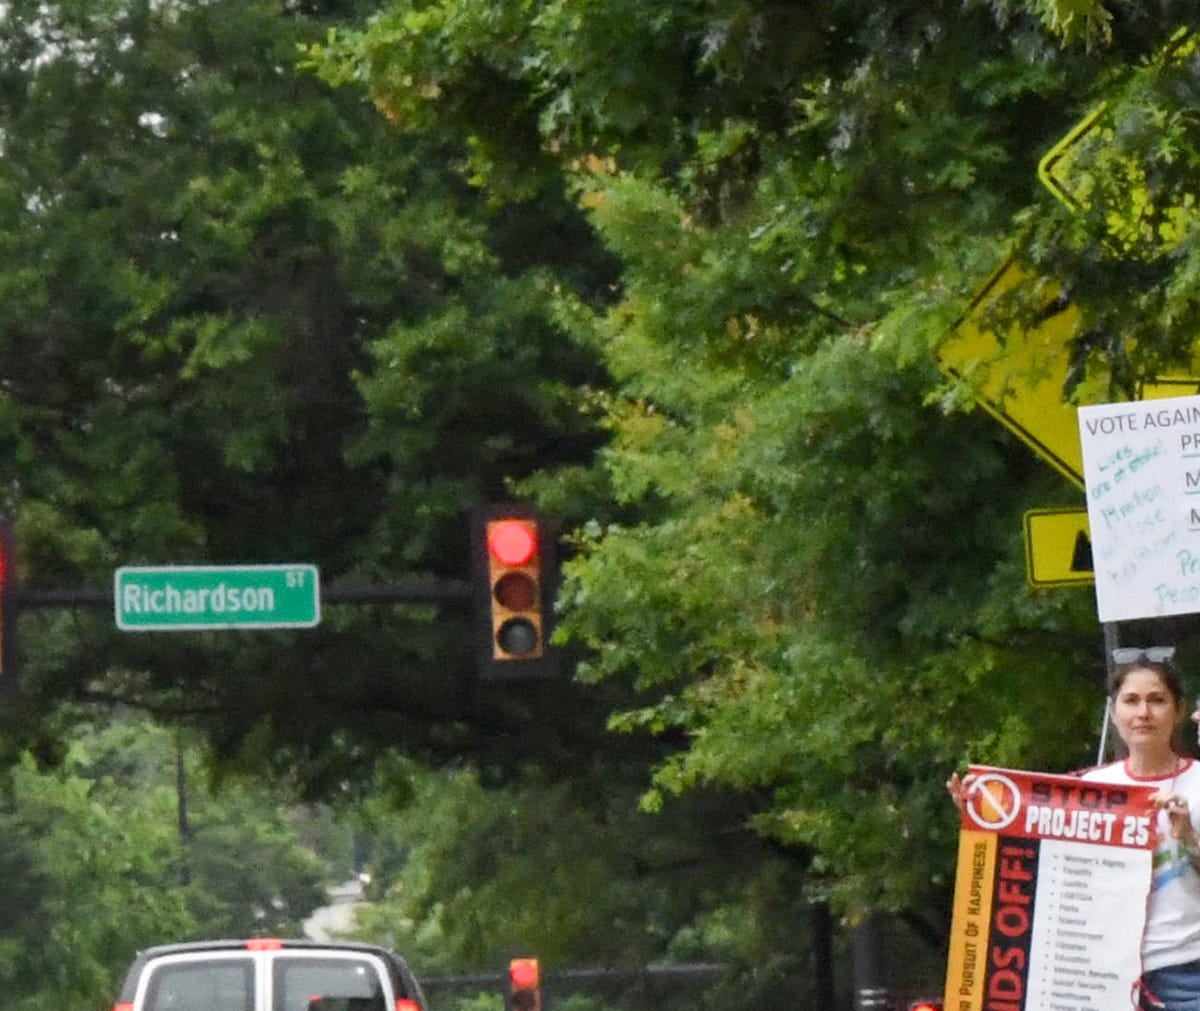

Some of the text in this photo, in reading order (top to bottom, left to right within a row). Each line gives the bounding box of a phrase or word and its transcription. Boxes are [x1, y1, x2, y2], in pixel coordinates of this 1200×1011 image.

[1085, 413, 1138, 437] VOTE
[123, 571, 306, 613] Richardson ST
[1025, 805, 1151, 846] PROJECT 25
[996, 846, 1036, 937] OFF!
[965, 921, 979, 937] OF
[958, 942, 977, 996] PURSUIT
